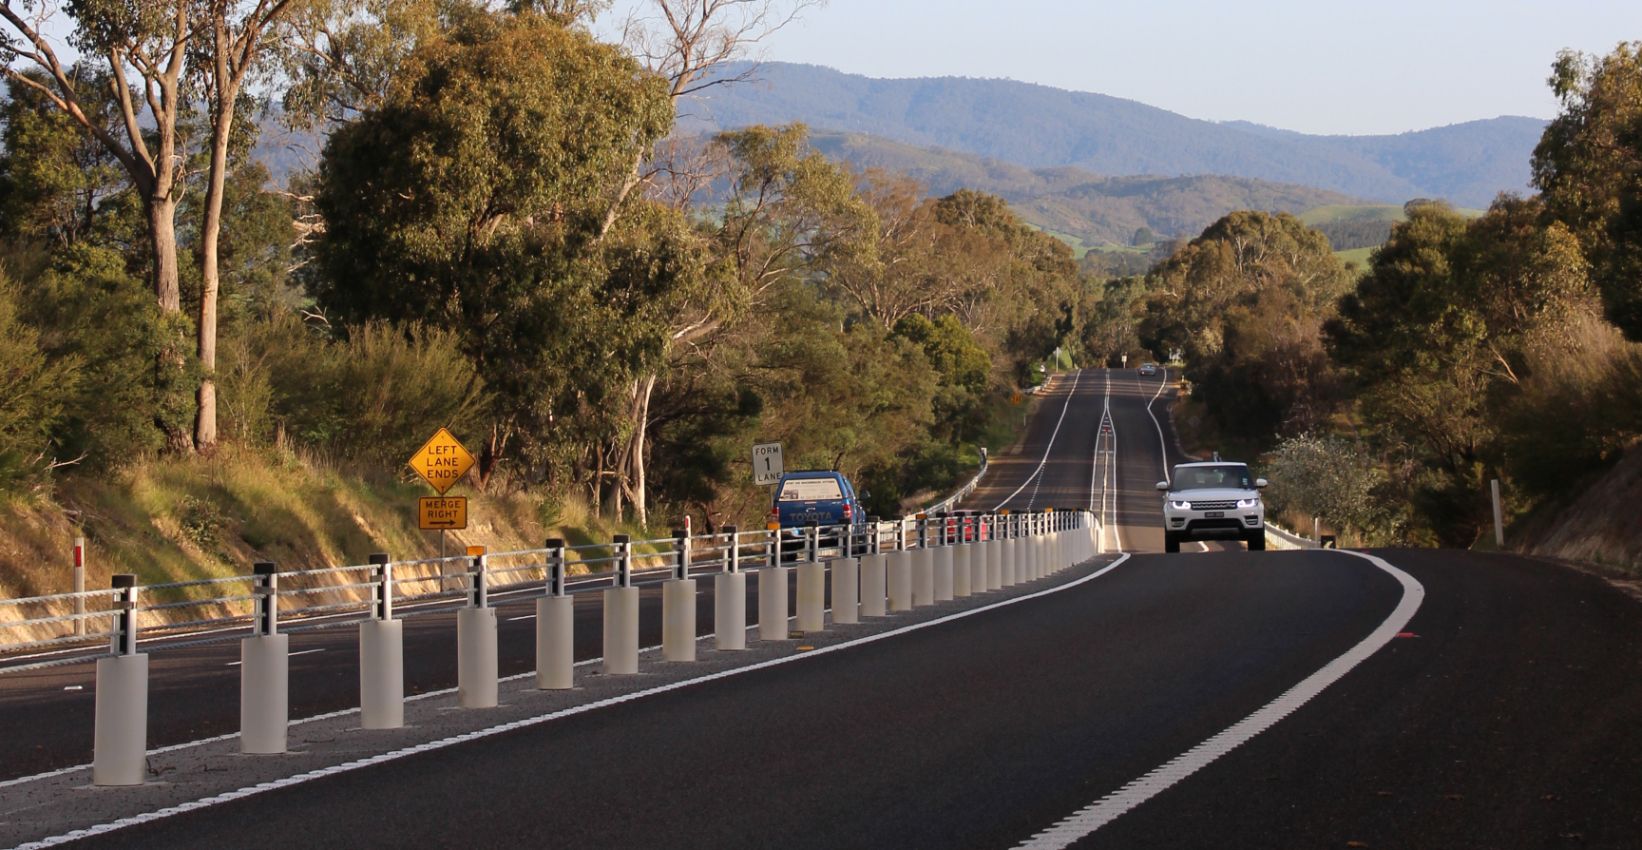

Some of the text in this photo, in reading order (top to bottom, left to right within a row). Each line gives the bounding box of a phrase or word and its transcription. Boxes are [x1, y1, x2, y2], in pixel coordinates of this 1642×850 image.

[428, 445, 457, 454] LEFT
[755, 447, 779, 455] FORM
[427, 458, 458, 466] LANE
[765, 457, 770, 471] 1
[427, 470, 458, 478] ENDS
[758, 473, 781, 481] LANE
[428, 510, 458, 518] RIGHT
[790, 512, 832, 521] TOYOTA
